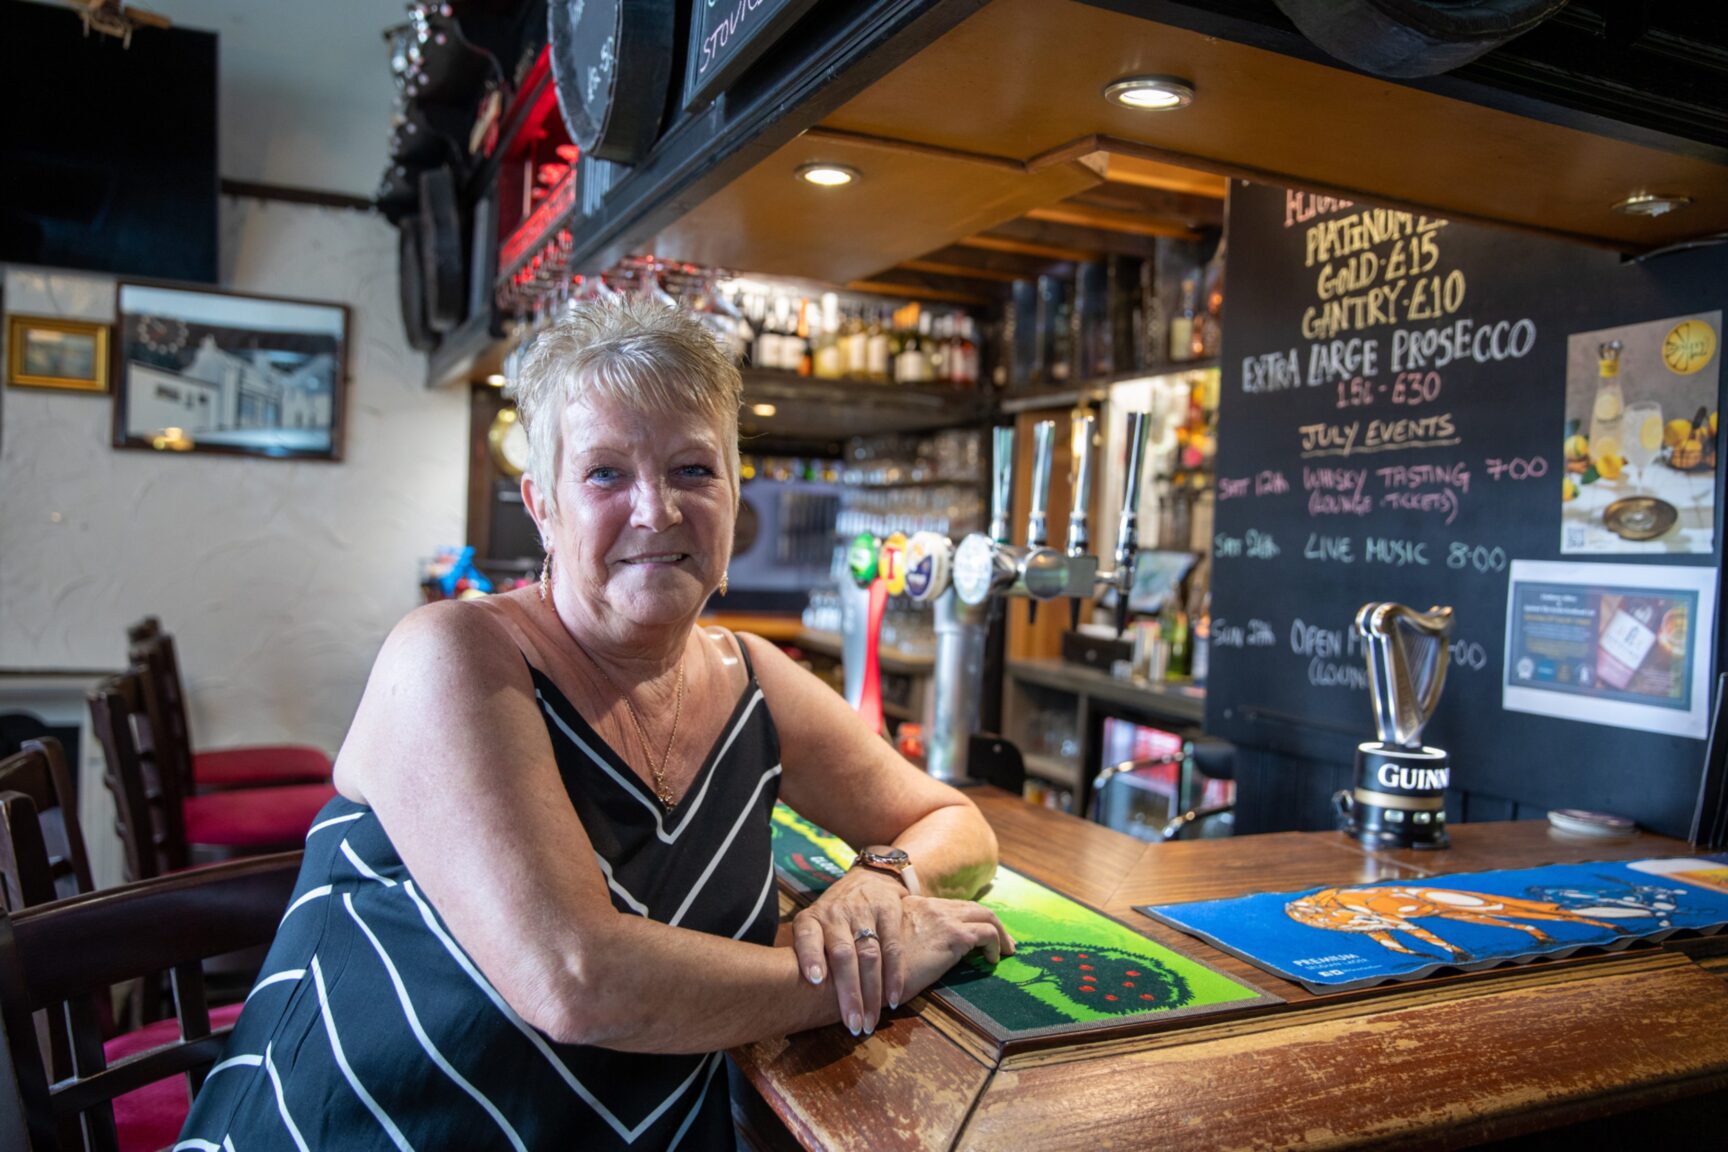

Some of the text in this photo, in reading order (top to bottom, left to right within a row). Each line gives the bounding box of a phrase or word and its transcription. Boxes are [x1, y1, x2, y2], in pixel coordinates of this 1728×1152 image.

[1304, 208, 1414, 268] PLATINUM
[1241, 318, 1538, 393] EXTRA LARGE PROSECCO
[1391, 371, 1442, 406] £30
[1298, 412, 1457, 458] JULY EVENTS
[1375, 461, 1471, 495] TASTING
[1303, 531, 1355, 563] LIVE
[1365, 536, 1430, 567] MUSIC
[1211, 618, 1245, 648] SUN
[1290, 617, 1342, 658] OPEN
